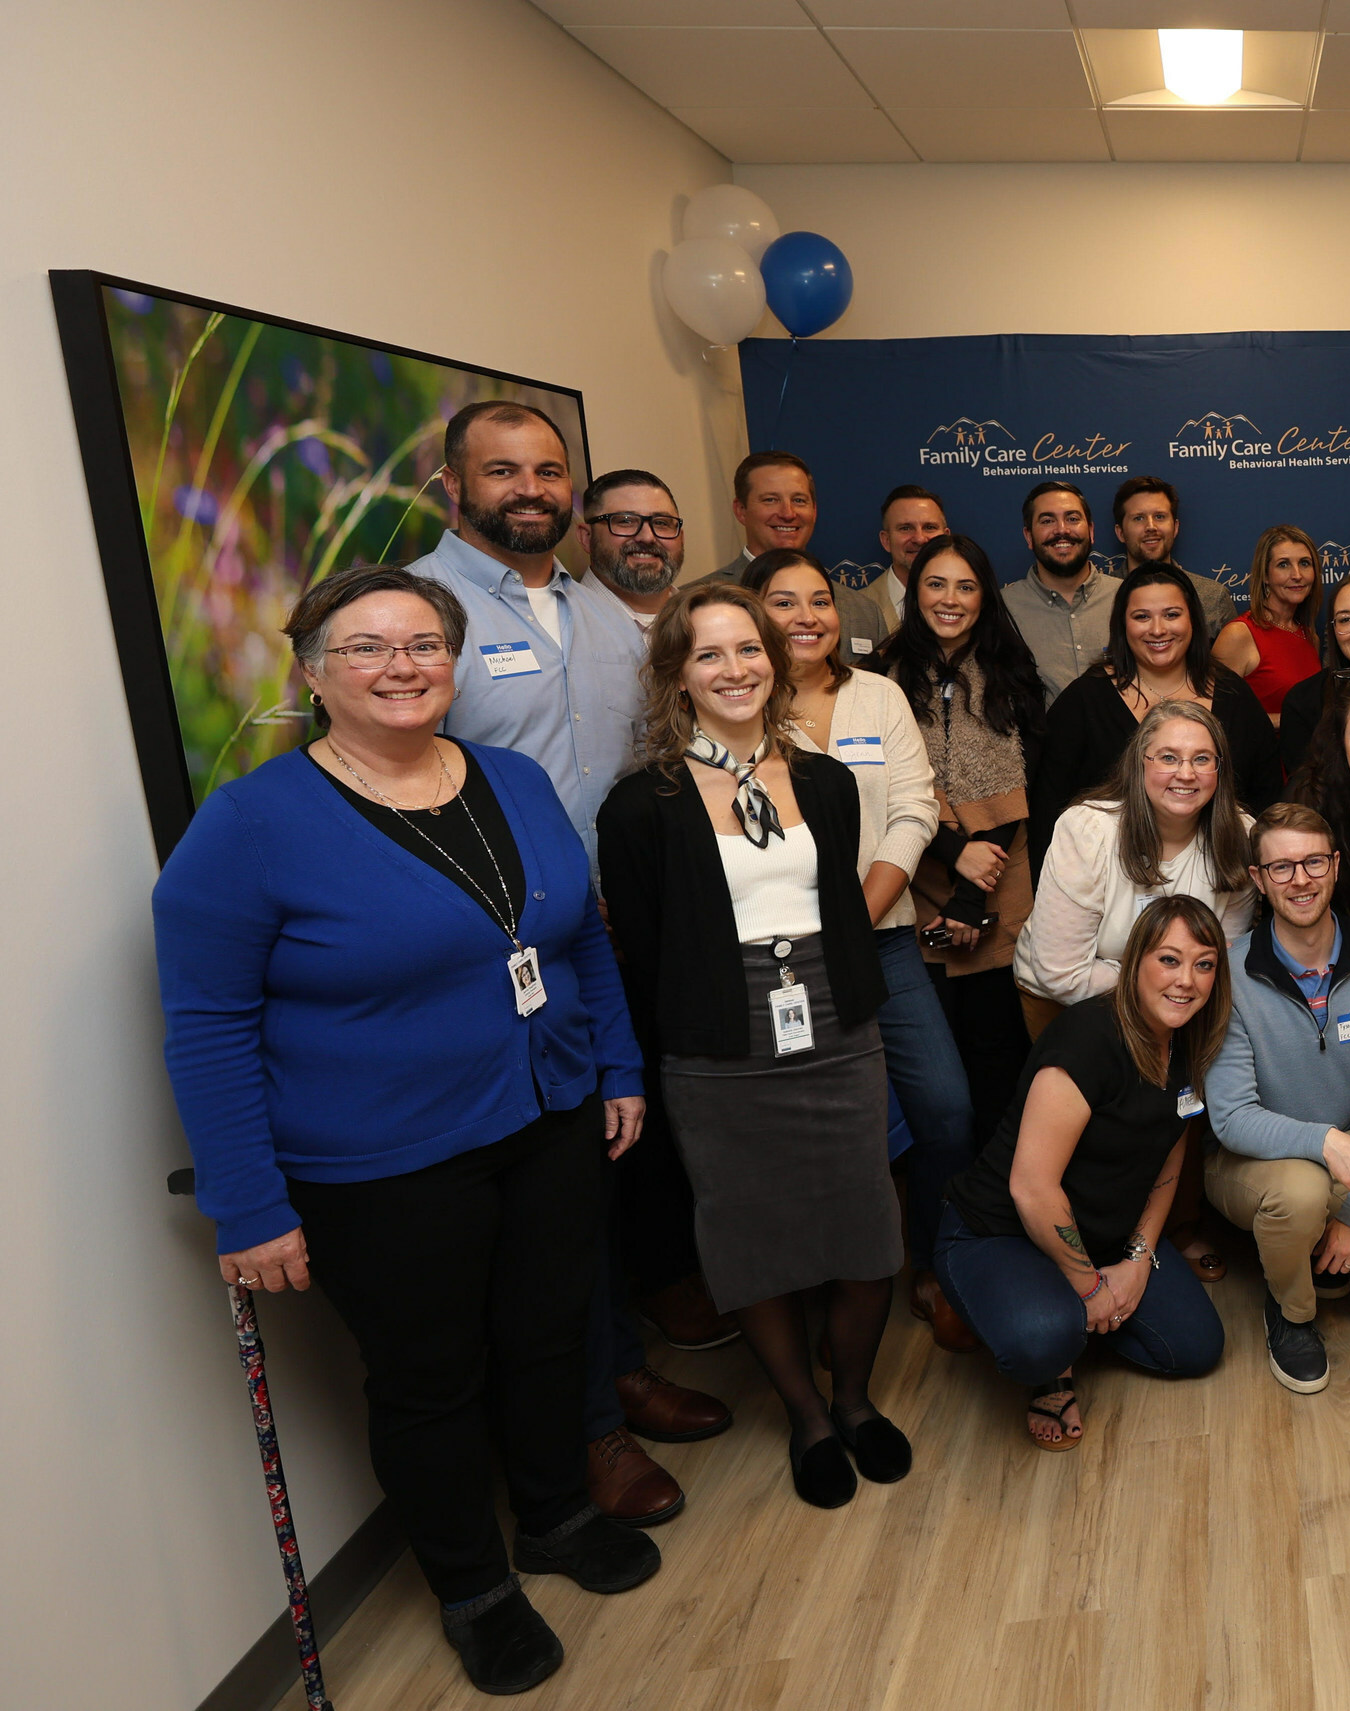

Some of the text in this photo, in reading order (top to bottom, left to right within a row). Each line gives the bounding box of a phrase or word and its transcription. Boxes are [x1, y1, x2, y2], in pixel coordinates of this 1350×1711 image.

[920, 432, 1132, 467] Family Care Center
[1169, 440, 1227, 460] Family
[1231, 439, 1271, 456] Care
[983, 463, 1128, 476] Behavioral Health Services
[1229, 458, 1286, 469] Behavioral
[1289, 456, 1324, 467] Health
[1212, 564, 1252, 587] ter
